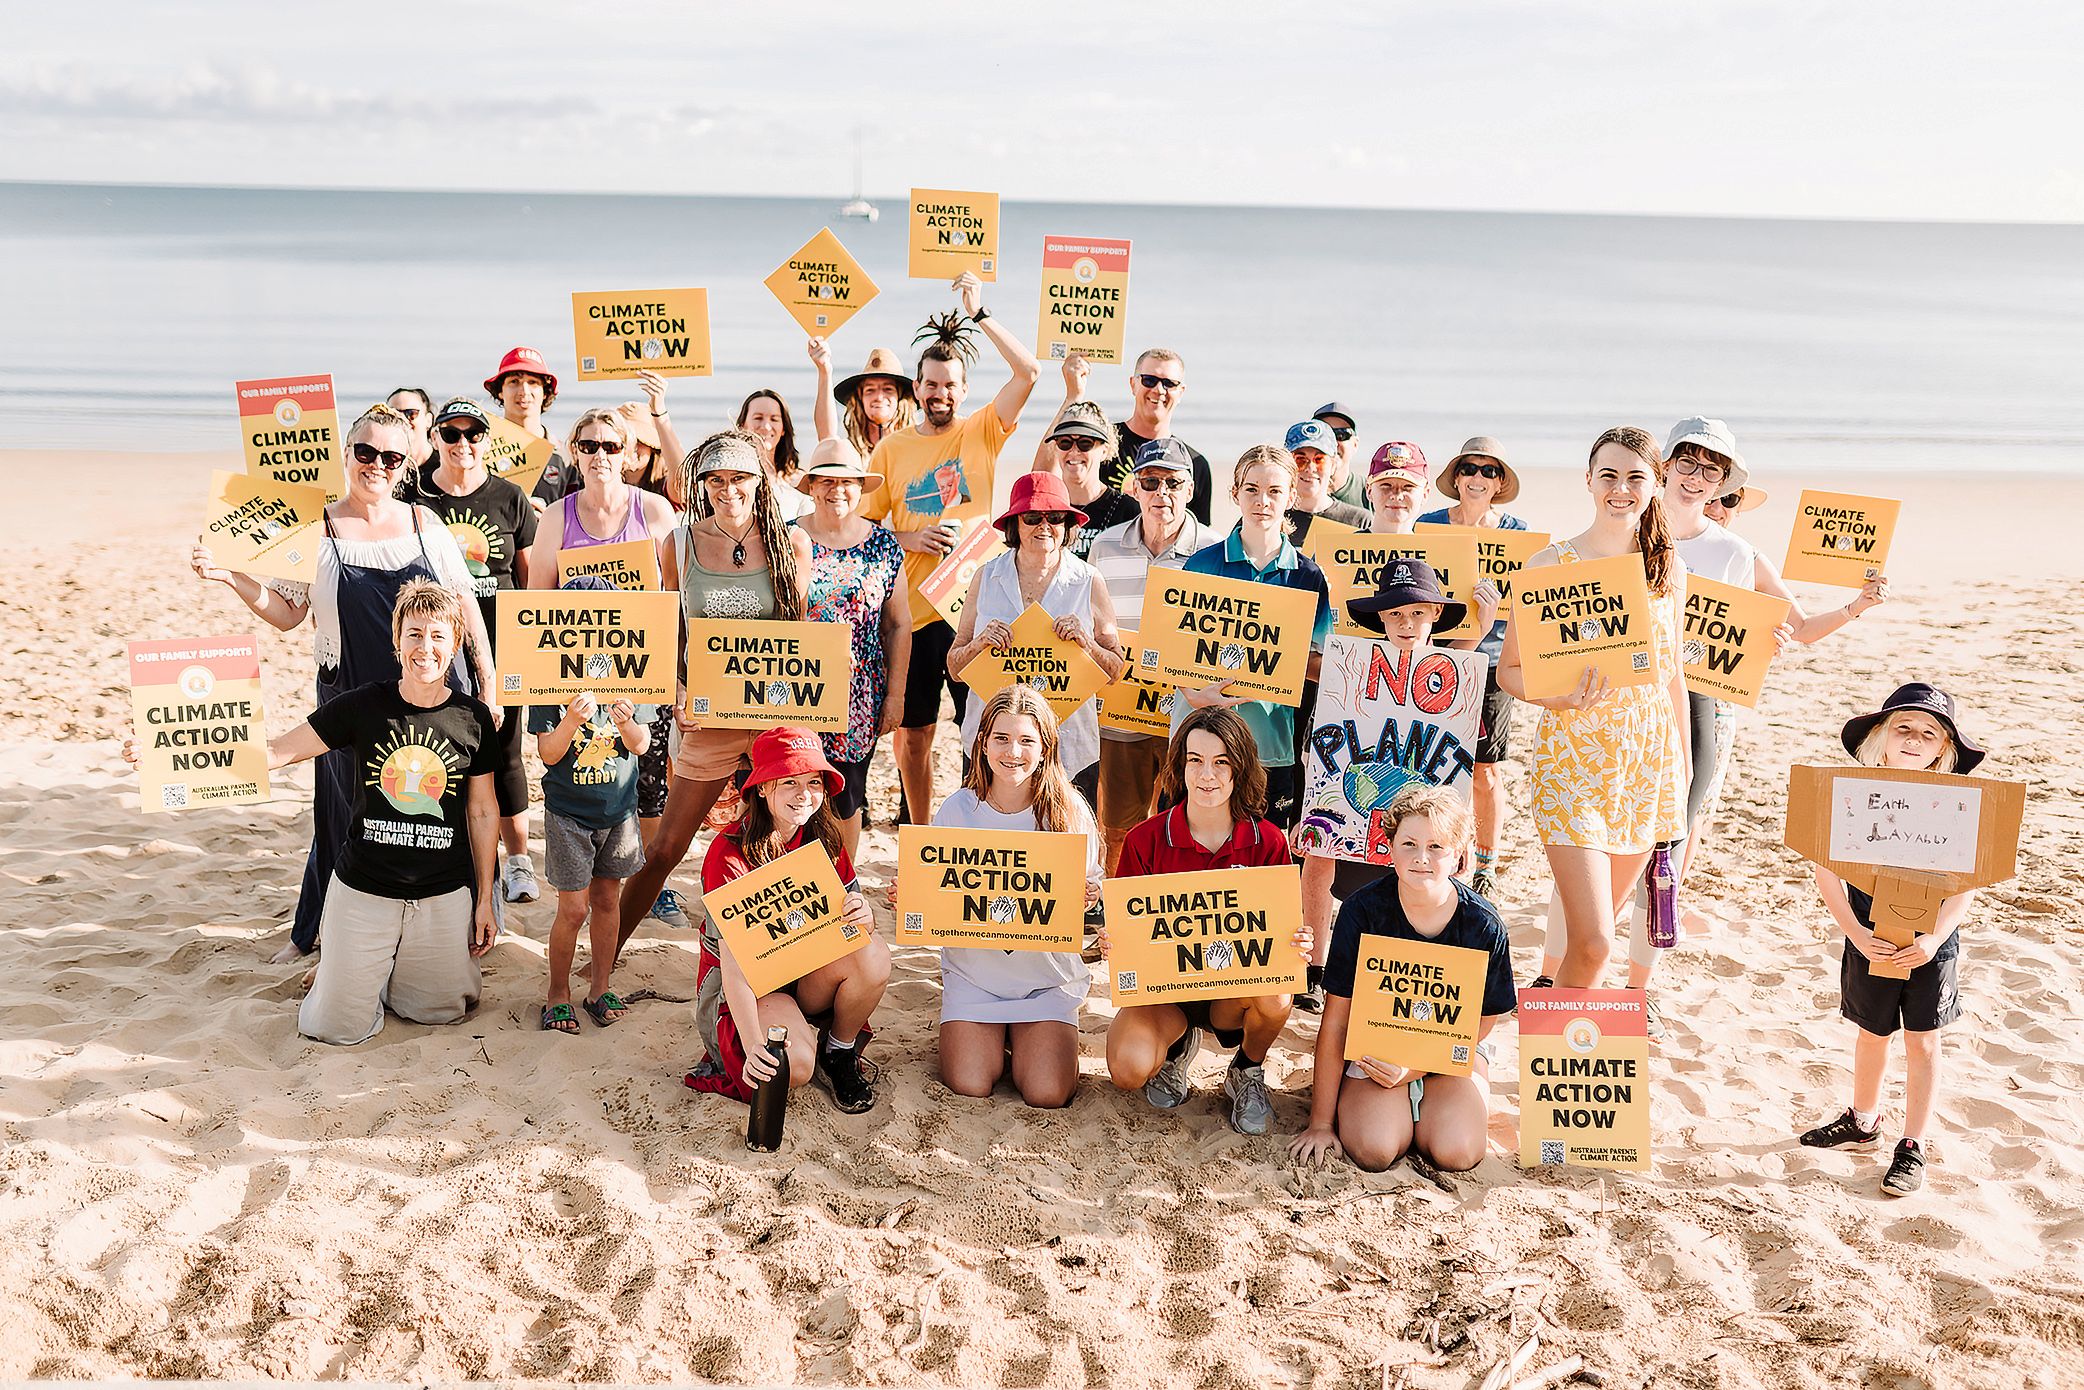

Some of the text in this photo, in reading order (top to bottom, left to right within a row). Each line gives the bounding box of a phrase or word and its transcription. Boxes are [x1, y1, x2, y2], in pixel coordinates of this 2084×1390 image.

[917, 204, 970, 215] CLIMATE
[927, 216, 982, 228] ACTION
[1065, 245, 1089, 253] FAMILY
[1090, 247, 1128, 256] SUPPORTS
[790, 261, 837, 272] CLIMATE
[798, 272, 848, 284] ACTION
[1049, 285, 1119, 301] CLIMATE
[589, 303, 666, 318] CLIMATE
[1051, 303, 1114, 318] ACTION
[606, 319, 685, 336] ACTION
[1061, 321, 1102, 335] NOW
[240, 383, 330, 398] OUR FAMILY SUPPORTS
[253, 428, 331, 447] CLIMATE
[259, 448, 329, 466] ACTION
[273, 468, 319, 483] NOW
[210, 496, 265, 533] CLIMATE
[230, 498, 286, 538] ACTION
[1805, 506, 1865, 521] CLIMATE
[1813, 519, 1876, 535] ACTION
[566, 560, 625, 577] CLIMATE
[602, 570, 640, 584] TION
[1522, 582, 1602, 605] CLIMATE
[1165, 588, 1260, 618] CLIMATE
[1541, 595, 1624, 621] ACTION
[518, 610, 621, 625] CLIMATE
[1178, 611, 1280, 645] ACTION
[1685, 612, 1746, 647] TION
[538, 630, 645, 648] ACTION
[708, 637, 799, 655] CLIMATE
[135, 647, 252, 662] OUR FAMILY SUPPORTS
[725, 656, 821, 677] ACTION
[1003, 660, 1067, 672] ACTION
[1365, 643, 1459, 714] NO
[147, 701, 251, 724] CLIMATE
[154, 725, 248, 748] ACTION
[173, 750, 234, 771] NOW
[1312, 718, 1475, 786] PLANET
[192, 785, 229, 793] AUSTRALIAN
[202, 789, 257, 800] CLIMATE ACTION
[374, 831, 414, 846] CLIMATE
[416, 836, 452, 849] ACTION
[415, 824, 454, 838] PARENTS
[921, 846, 1027, 867] CLIMATE
[940, 868, 1051, 893] ACTION
[722, 877, 795, 920] CLIMATE
[745, 881, 819, 929] ACTION
[1127, 890, 1237, 916] CLIMATE
[1151, 911, 1266, 940] ACTION
[756, 915, 842, 960] togetherwecanmovement.org
[931, 929, 1072, 943] togetherwecanmovement.org.au
[1367, 958, 1444, 980] CLIMATE
[1147, 975, 1294, 993] togetherwecanmovement.org.au
[1378, 976, 1460, 1001] ACTION
[1524, 1002, 1640, 1012] OUR FAMILY SUPPORTS
[1368, 1020, 1471, 1040] togetherwecanmovement.org.au
[1531, 1058, 1636, 1077] CLIMATE
[1536, 1084, 1631, 1103] ACTION
[1553, 1109, 1616, 1128] NOW
[1609, 1147, 1637, 1155] PARENTS
